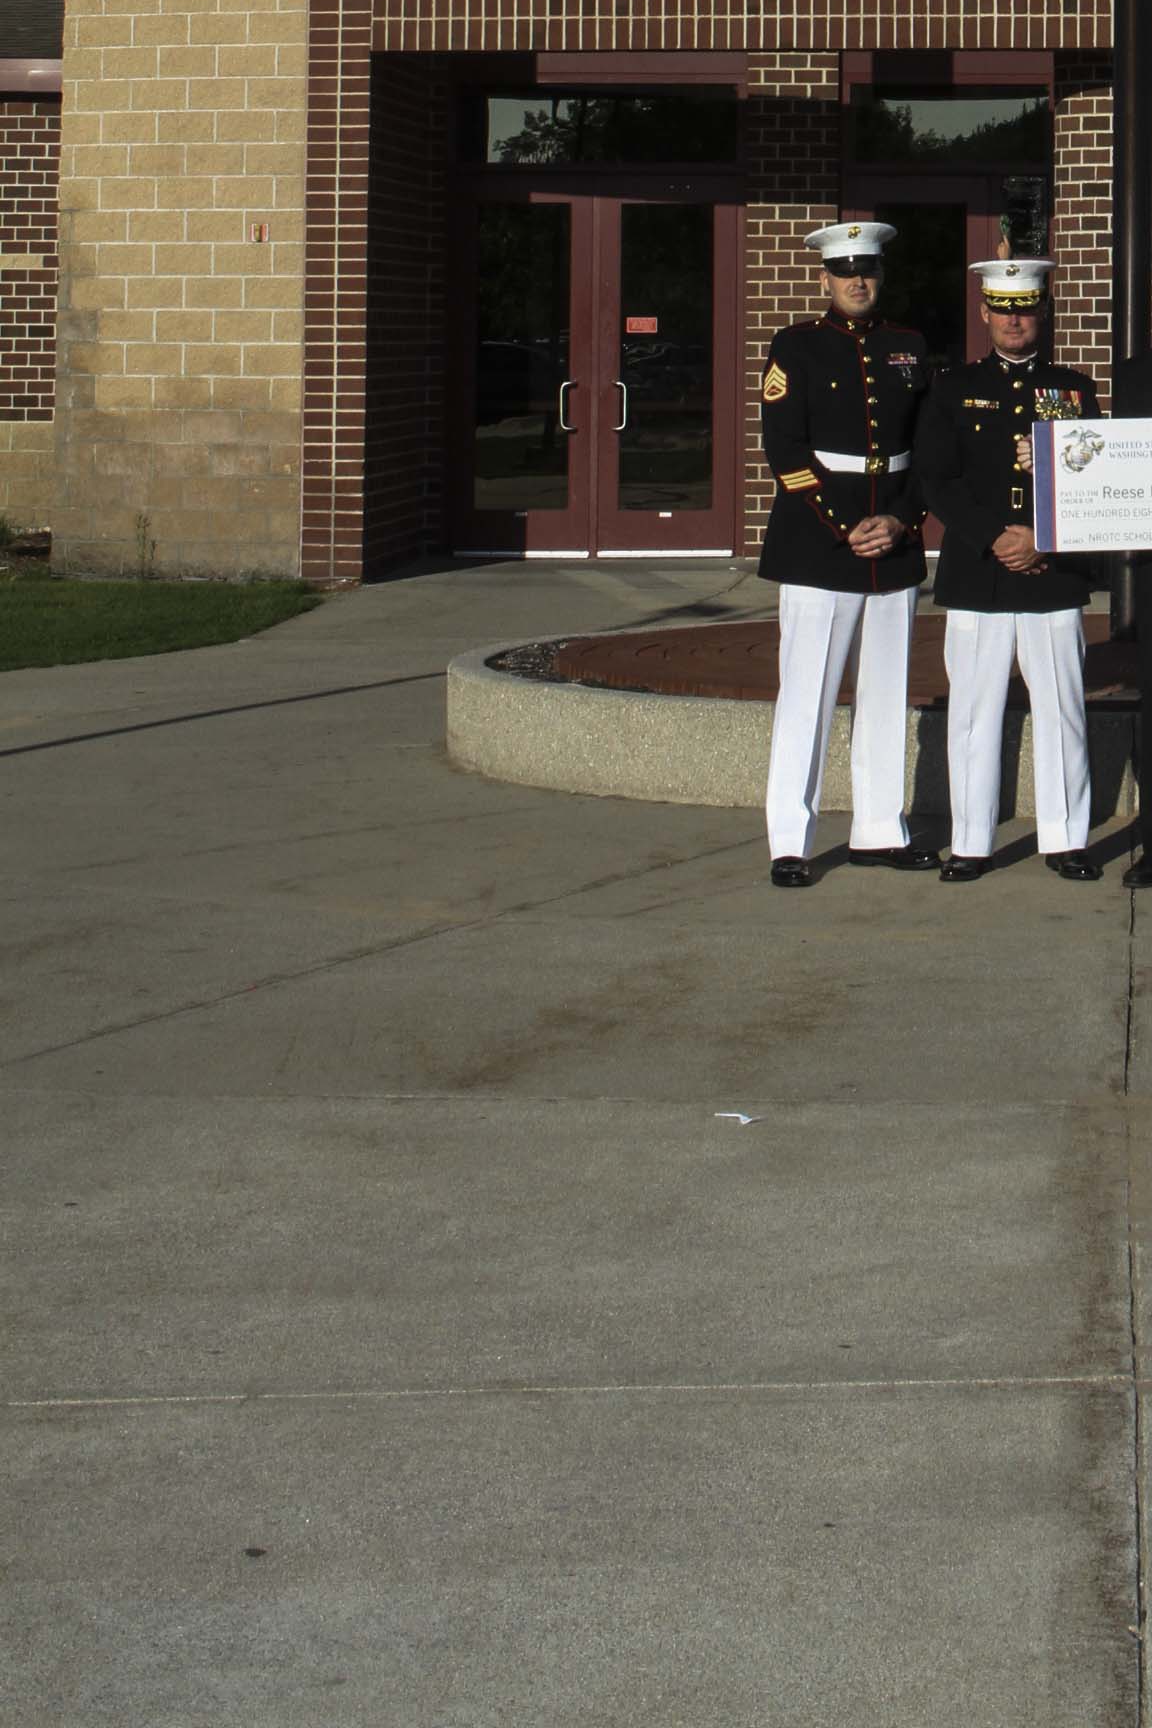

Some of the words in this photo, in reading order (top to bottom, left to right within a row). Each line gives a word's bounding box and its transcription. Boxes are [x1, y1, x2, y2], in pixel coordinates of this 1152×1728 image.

[1108, 441, 1142, 449] UNITED
[1102, 485, 1145, 499] Reese
[1061, 510, 1081, 519] ONE
[1083, 508, 1130, 519] HUNDRED
[1088, 532, 1120, 544] NROTC
